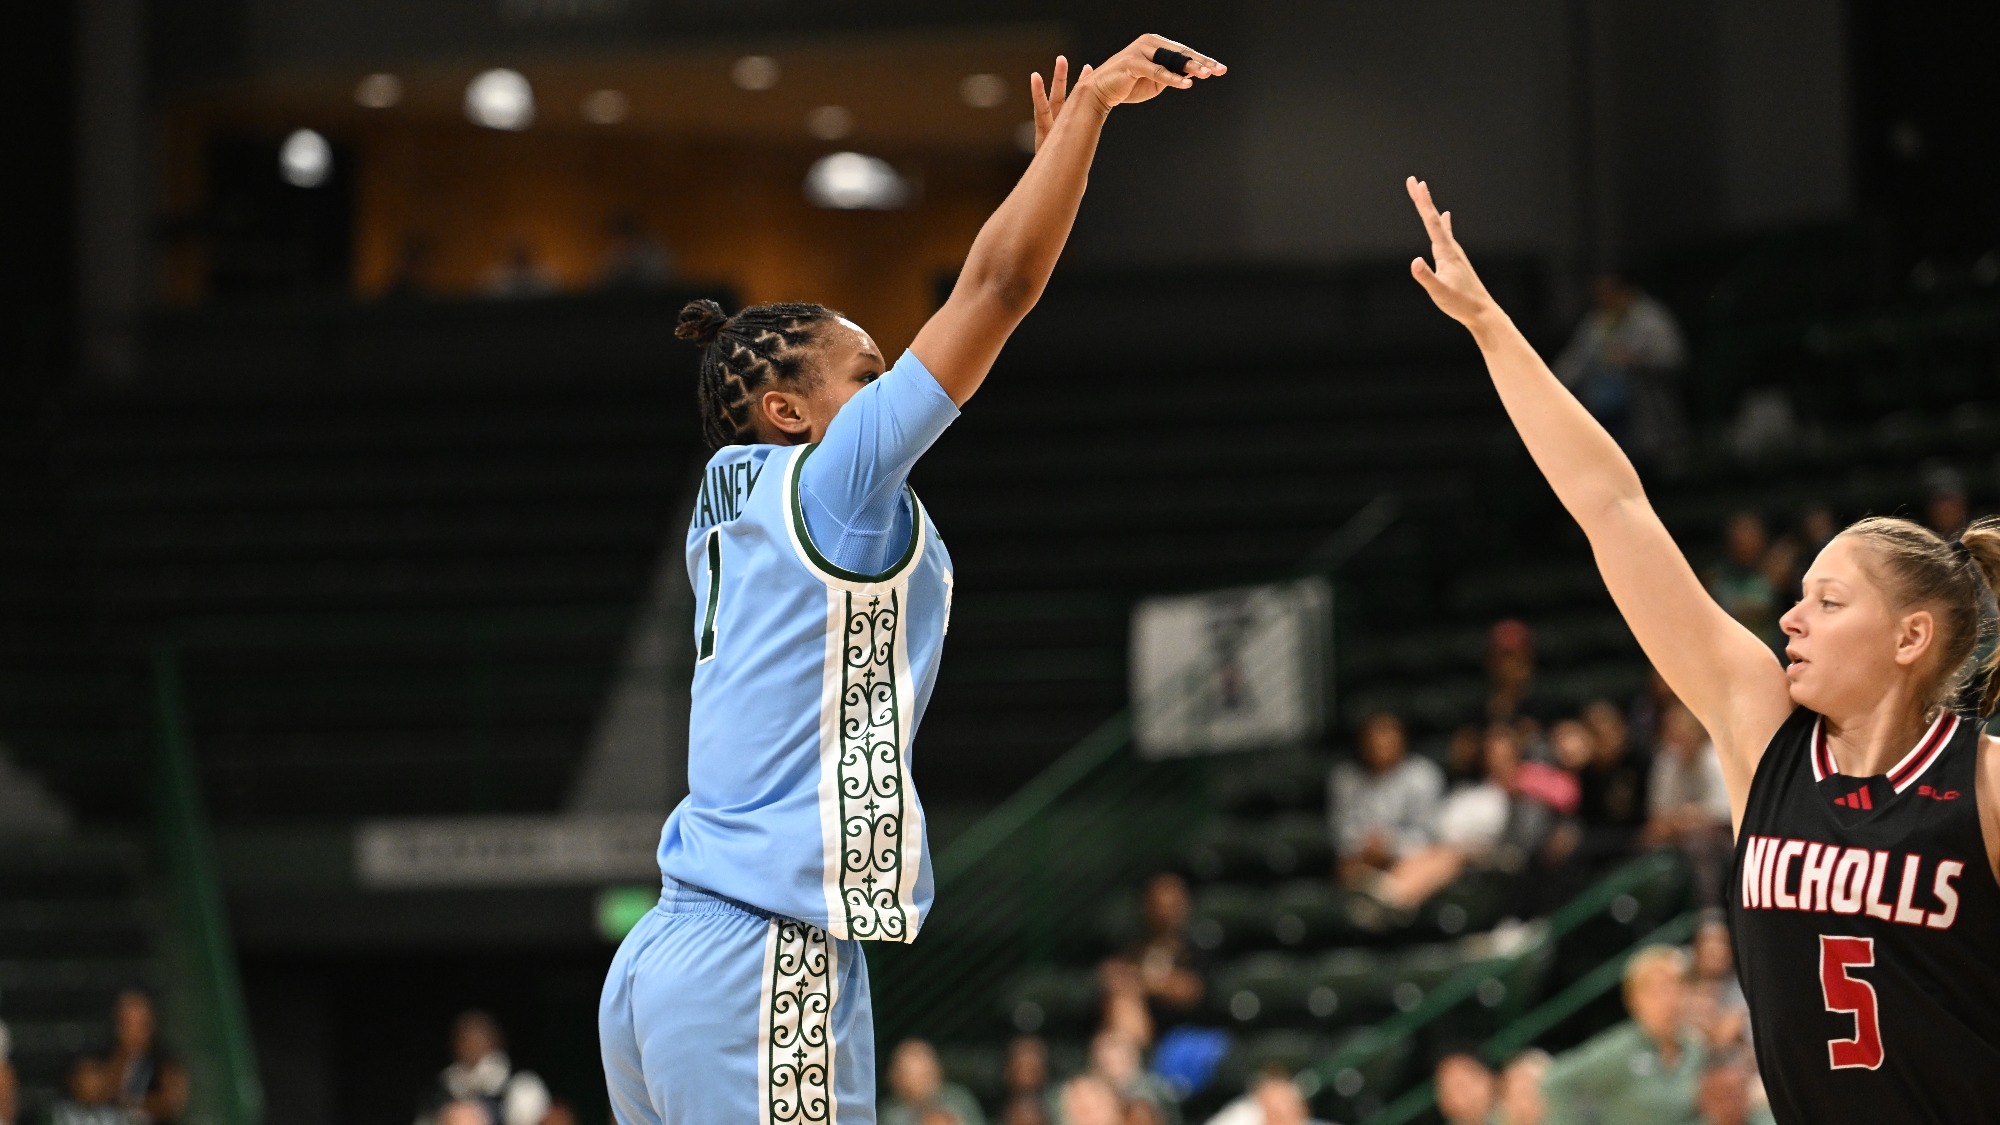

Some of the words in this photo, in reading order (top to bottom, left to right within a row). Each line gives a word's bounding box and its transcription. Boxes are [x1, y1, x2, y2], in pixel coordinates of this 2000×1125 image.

[694, 460, 765, 529] AINEY
[698, 525, 721, 665] 1
[1742, 834, 1965, 930] NICHOLLS
[1819, 934, 1885, 1071] 5
